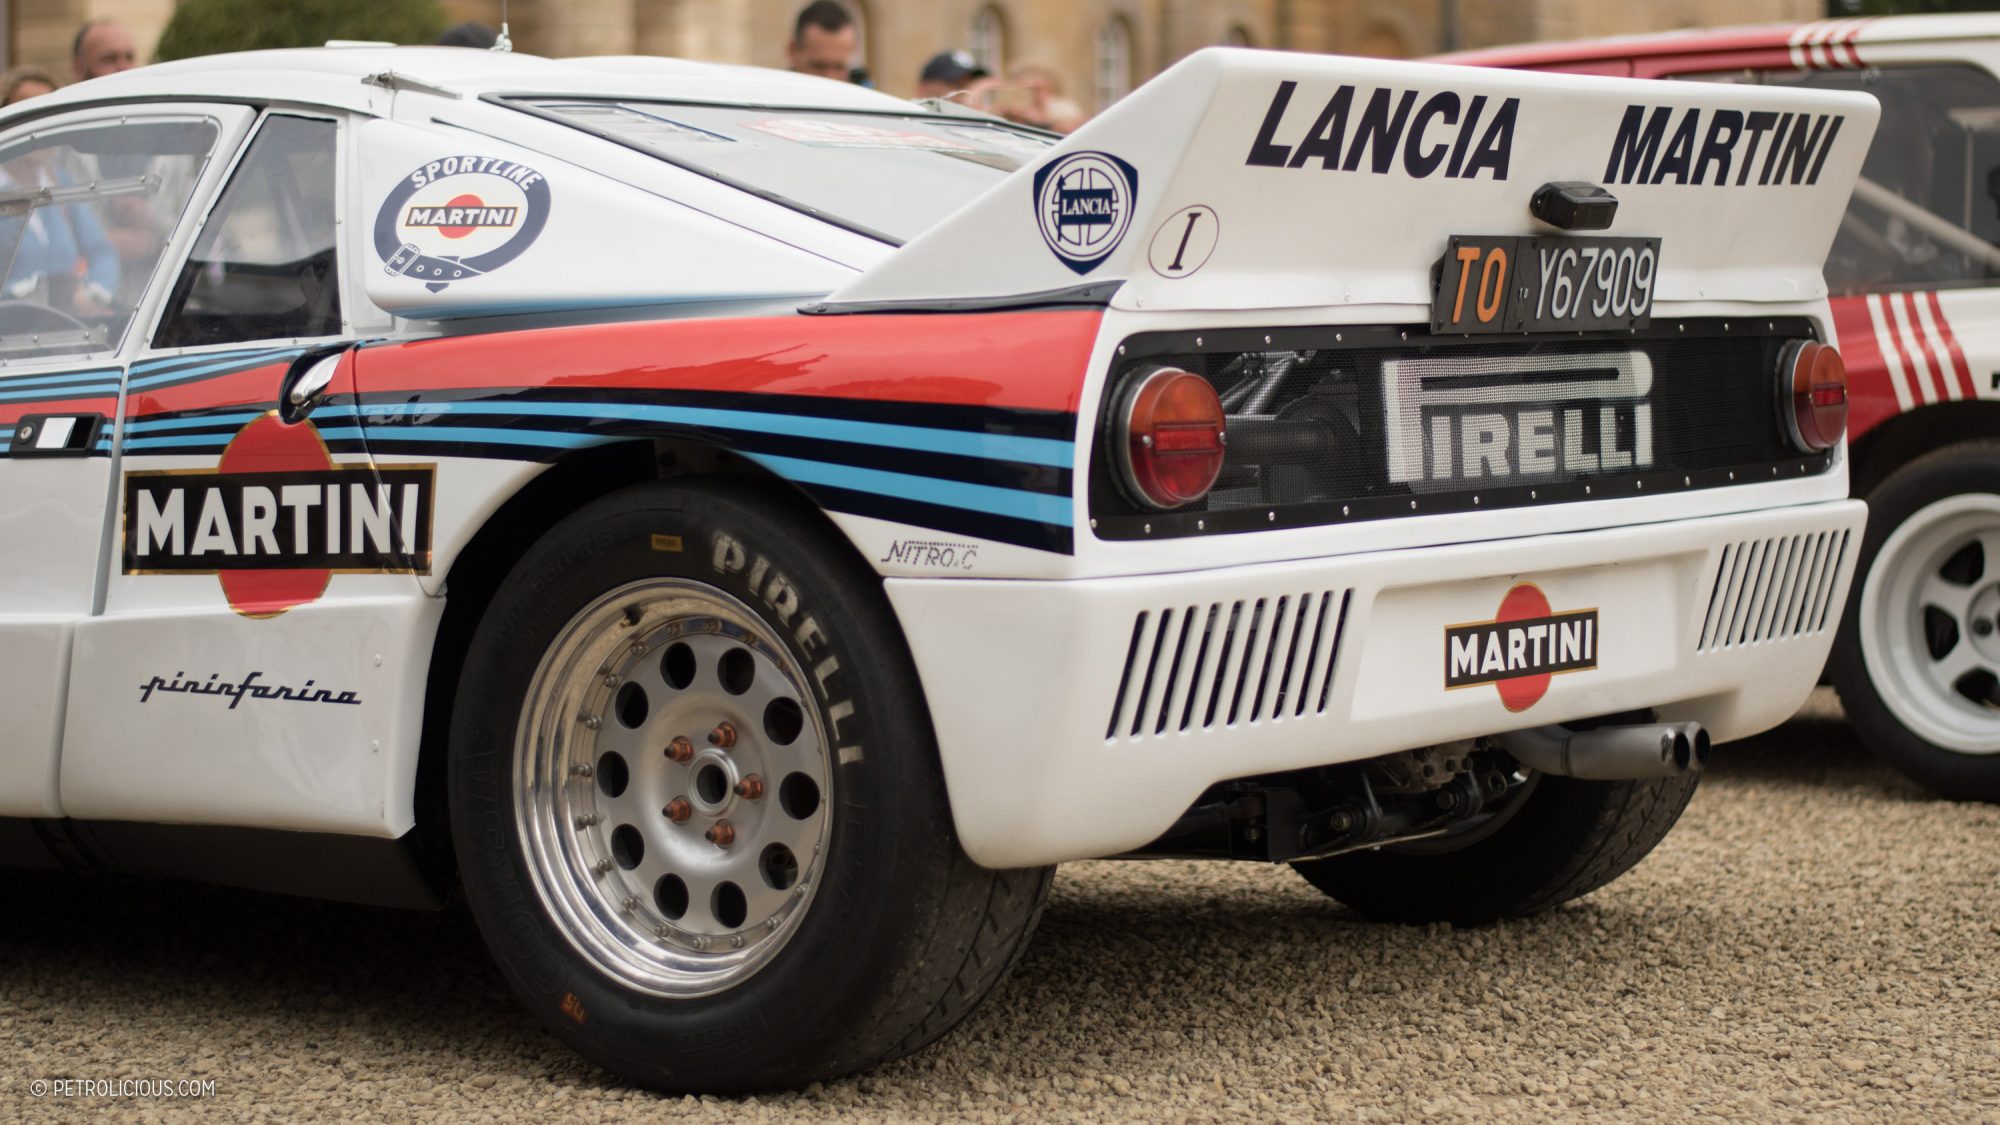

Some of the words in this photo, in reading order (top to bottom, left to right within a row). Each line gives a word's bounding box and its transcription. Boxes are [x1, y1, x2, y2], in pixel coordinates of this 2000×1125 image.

[1245, 80, 1521, 181] LANCIA
[1602, 104, 1845, 187] MARTINI
[411, 156, 543, 191] SPORTLINE
[1062, 198, 1112, 215] LANCIA
[409, 208, 515, 225] MARTINI
[1452, 247, 1507, 324] TO
[1535, 247, 1655, 320] Y67909
[1382, 350, 1653, 483] PIRELLI
[137, 483, 419, 556] MARTINI
[712, 532, 864, 766] PIRELLI
[1450, 619, 1593, 678] MARTINI
[139, 671, 363, 710] pininfarina
